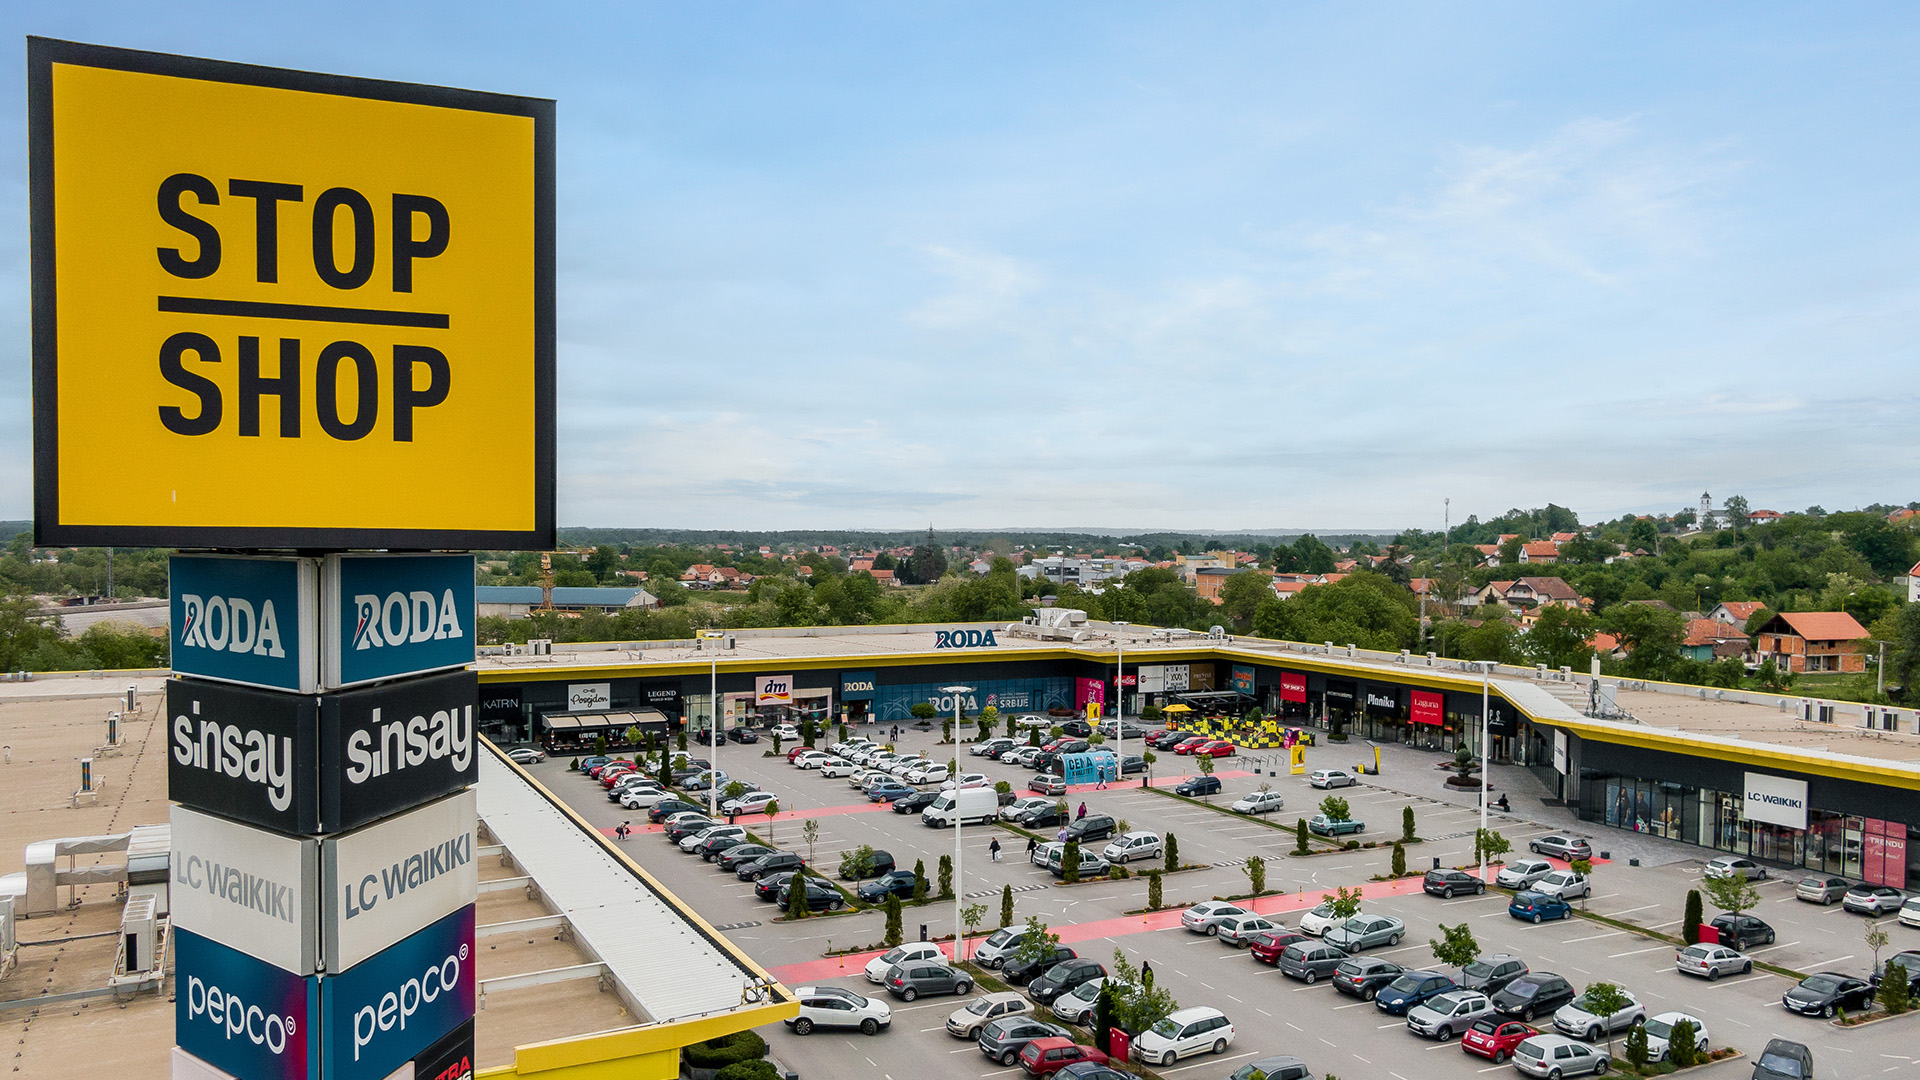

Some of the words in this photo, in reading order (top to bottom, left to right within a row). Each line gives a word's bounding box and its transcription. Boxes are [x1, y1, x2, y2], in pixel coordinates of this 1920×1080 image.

[156, 172, 450, 293] STOP
[158, 331, 451, 442] SHOP
[180, 593, 285, 658] RODA
[352, 588, 463, 651] RODA
[934, 629, 998, 648] RODA
[648, 690, 677, 698] LEGEND
[764, 680, 787, 693] dm
[844, 681, 875, 692] RODA
[1000, 699, 1029, 708] SRBIJE
[1367, 693, 1395, 708] Planika
[1414, 698, 1439, 708] Laguna
[173, 700, 292, 812] sinsay
[346, 704, 473, 784] sinsay
[1748, 792, 1760, 801] LC
[1869, 836, 1904, 849] TRENDU
[176, 850, 202, 890] LC
[345, 873, 378, 920] LC
[188, 974, 286, 1055] pepco
[354, 954, 460, 1062] pepco
